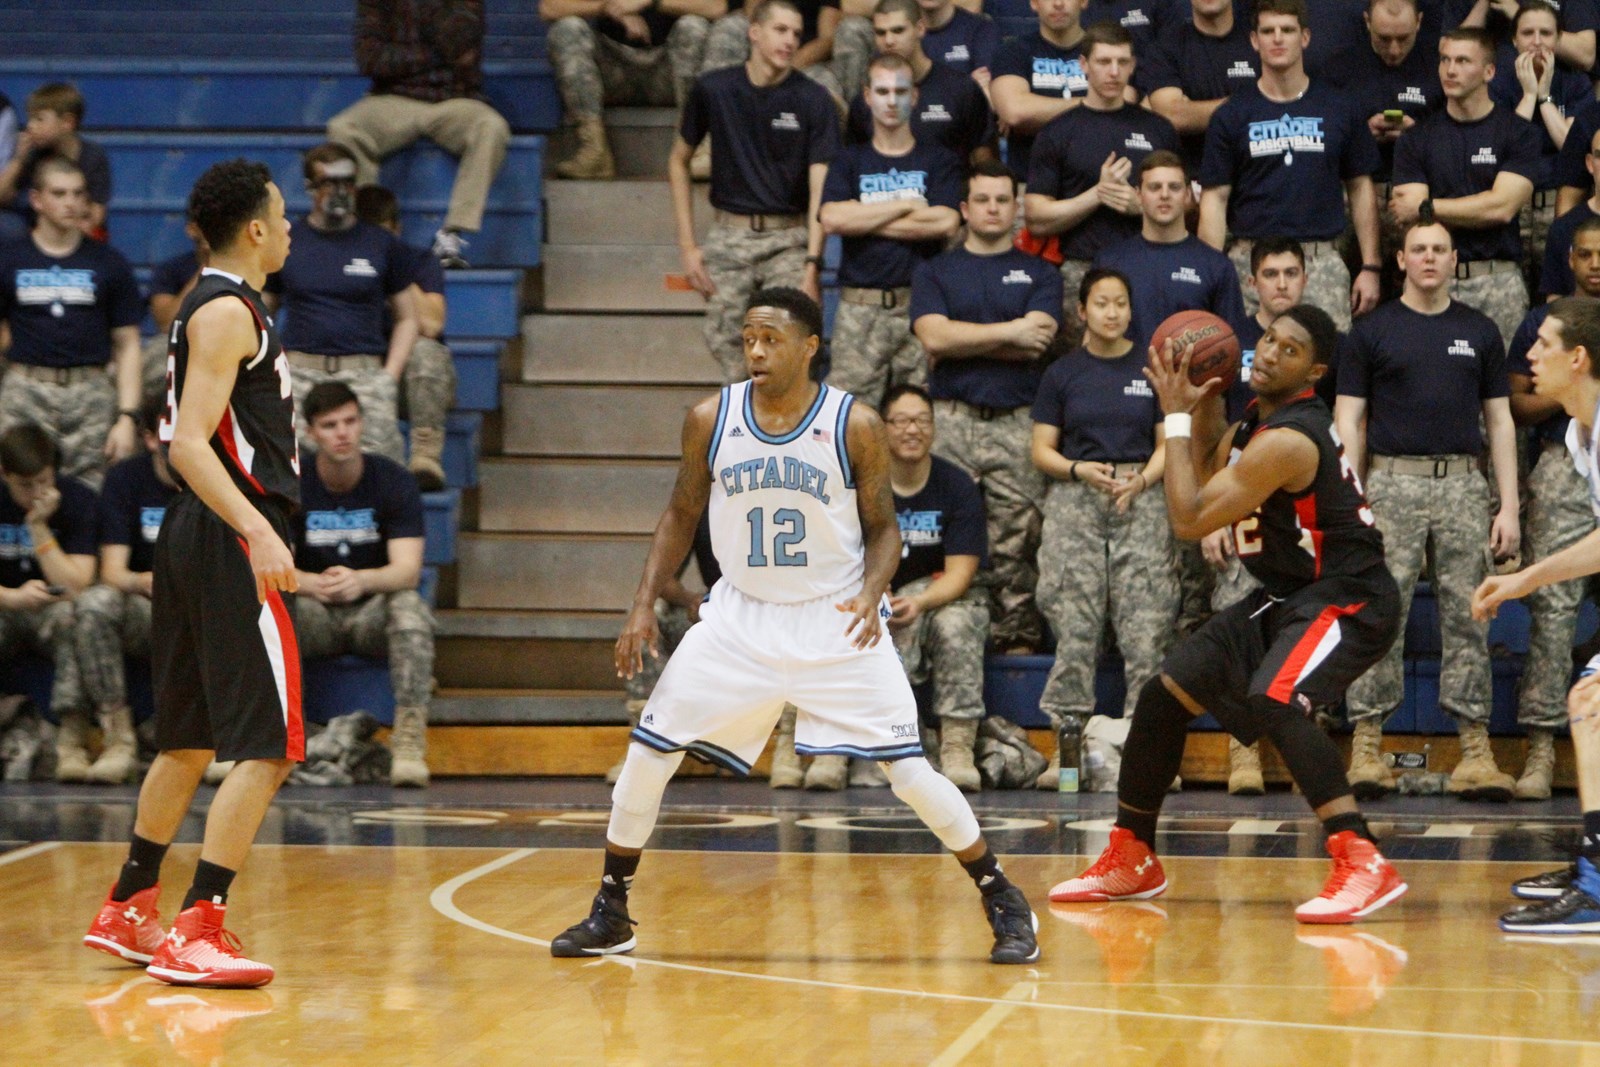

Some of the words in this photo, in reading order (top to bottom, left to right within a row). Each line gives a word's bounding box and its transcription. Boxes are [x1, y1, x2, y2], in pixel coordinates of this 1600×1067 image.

[1234, 61, 1248, 69] THE
[1227, 67, 1256, 78] CITADEL
[1406, 86, 1421, 95] THE
[1398, 92, 1426, 105] CITADEL
[1249, 119, 1325, 142] CITADEL
[1131, 132, 1145, 141] THE
[1125, 138, 1153, 151] CITADEL
[1249, 136, 1325, 152] BASKETBALL
[1471, 154, 1497, 164] CITADEL
[859, 173, 926, 193] CITADEL
[1454, 339, 1469, 347] THE
[1448, 346, 1475, 357] CITADEL
[1131, 380, 1147, 388] THE
[1123, 386, 1153, 398] CITADEL
[720, 456, 830, 504] CITADEL
[747, 507, 808, 567] 12
